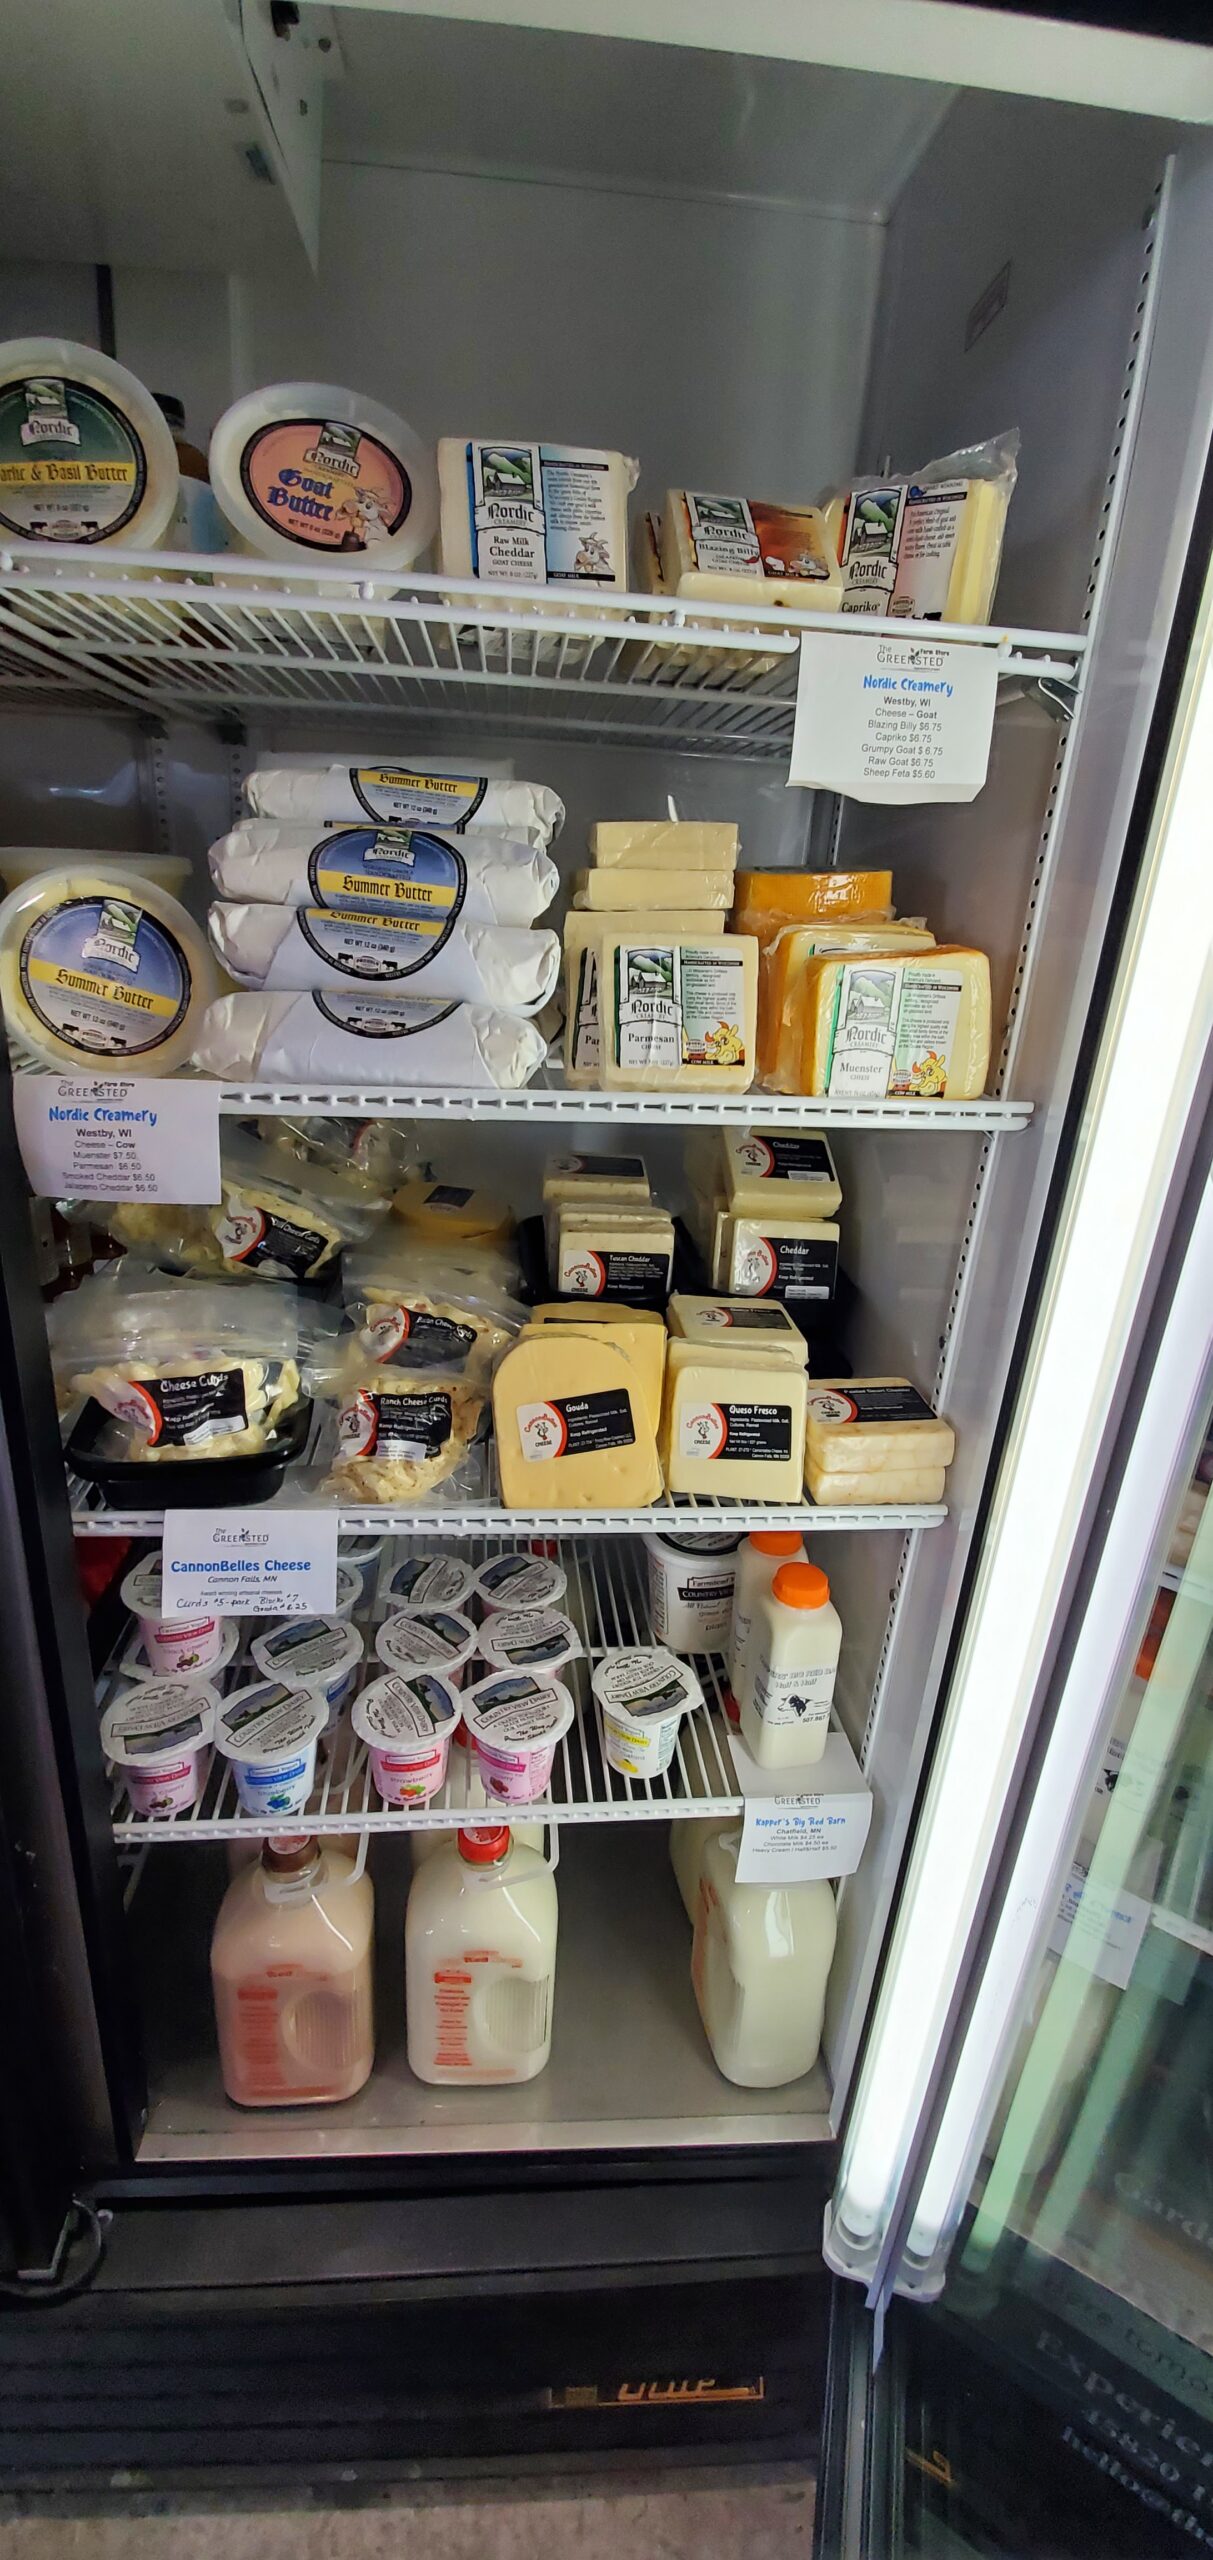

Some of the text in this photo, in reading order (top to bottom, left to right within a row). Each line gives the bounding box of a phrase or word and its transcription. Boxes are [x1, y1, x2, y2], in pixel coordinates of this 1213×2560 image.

[311, 451, 357, 474] Nordic
[0, 463, 128, 482] arlic & Basil Butter
[278, 468, 335, 499] Goat
[267, 486, 334, 521] Butter
[488, 503, 535, 522] Nordic
[704, 526, 747, 540] Nordic
[493, 535, 530, 546] Raw Milk
[489, 546, 535, 558] Cheddar
[850, 561, 887, 579] Nordic
[841, 601, 878, 613] Capriko
[879, 645, 892, 653] The
[877, 652, 944, 667] GREENSTED
[863, 675, 953, 697] Nordic Creamery
[883, 696, 931, 707] Westby, WI
[875, 708, 937, 719] Cheese Goat
[868, 720, 942, 732] Blazing Billy $6.75
[875, 732, 932, 744] Capriko $6.75
[861, 744, 894, 755] Grumpy
[895, 745, 916, 755] Goat
[868, 756, 934, 767] Raw Goat $6.75
[863, 768, 936, 779] Sheep Feta $5.60
[379, 772, 458, 793] Summer Butter
[372, 847, 410, 859] Nordic
[342, 875, 433, 902] Summer Butter
[382, 916, 420, 931] Butter
[94, 938, 135, 963] Nordic
[56, 968, 153, 1010] Summer Butter
[632, 1000, 673, 1015] Nordic
[628, 1033, 674, 1043] Parmesan
[847, 1026, 887, 1044] Nordic
[840, 1063, 883, 1074] Muenster
[49, 1106, 157, 1126] Nordic Creamery
[76, 1129, 132, 1138] Westby, WI
[73, 1162, 113, 1170] Parmesan
[62, 1172, 94, 1180] Smoked
[96, 1173, 130, 1181] Cheddar
[780, 1245, 809, 1255] Cheddar
[160, 1379, 197, 1393] Cheese
[381, 1397, 401, 1405] Ranch
[403, 1397, 427, 1406] Cheese
[566, 1402, 589, 1412] Gouda
[729, 1405, 777, 1415] Queso Fresco
[171, 1560, 311, 1573] CannonBelles Cheese
[793, 1817, 805, 1828] Big
[808, 1817, 823, 1825] Red
[827, 1816, 846, 1825] Barn
